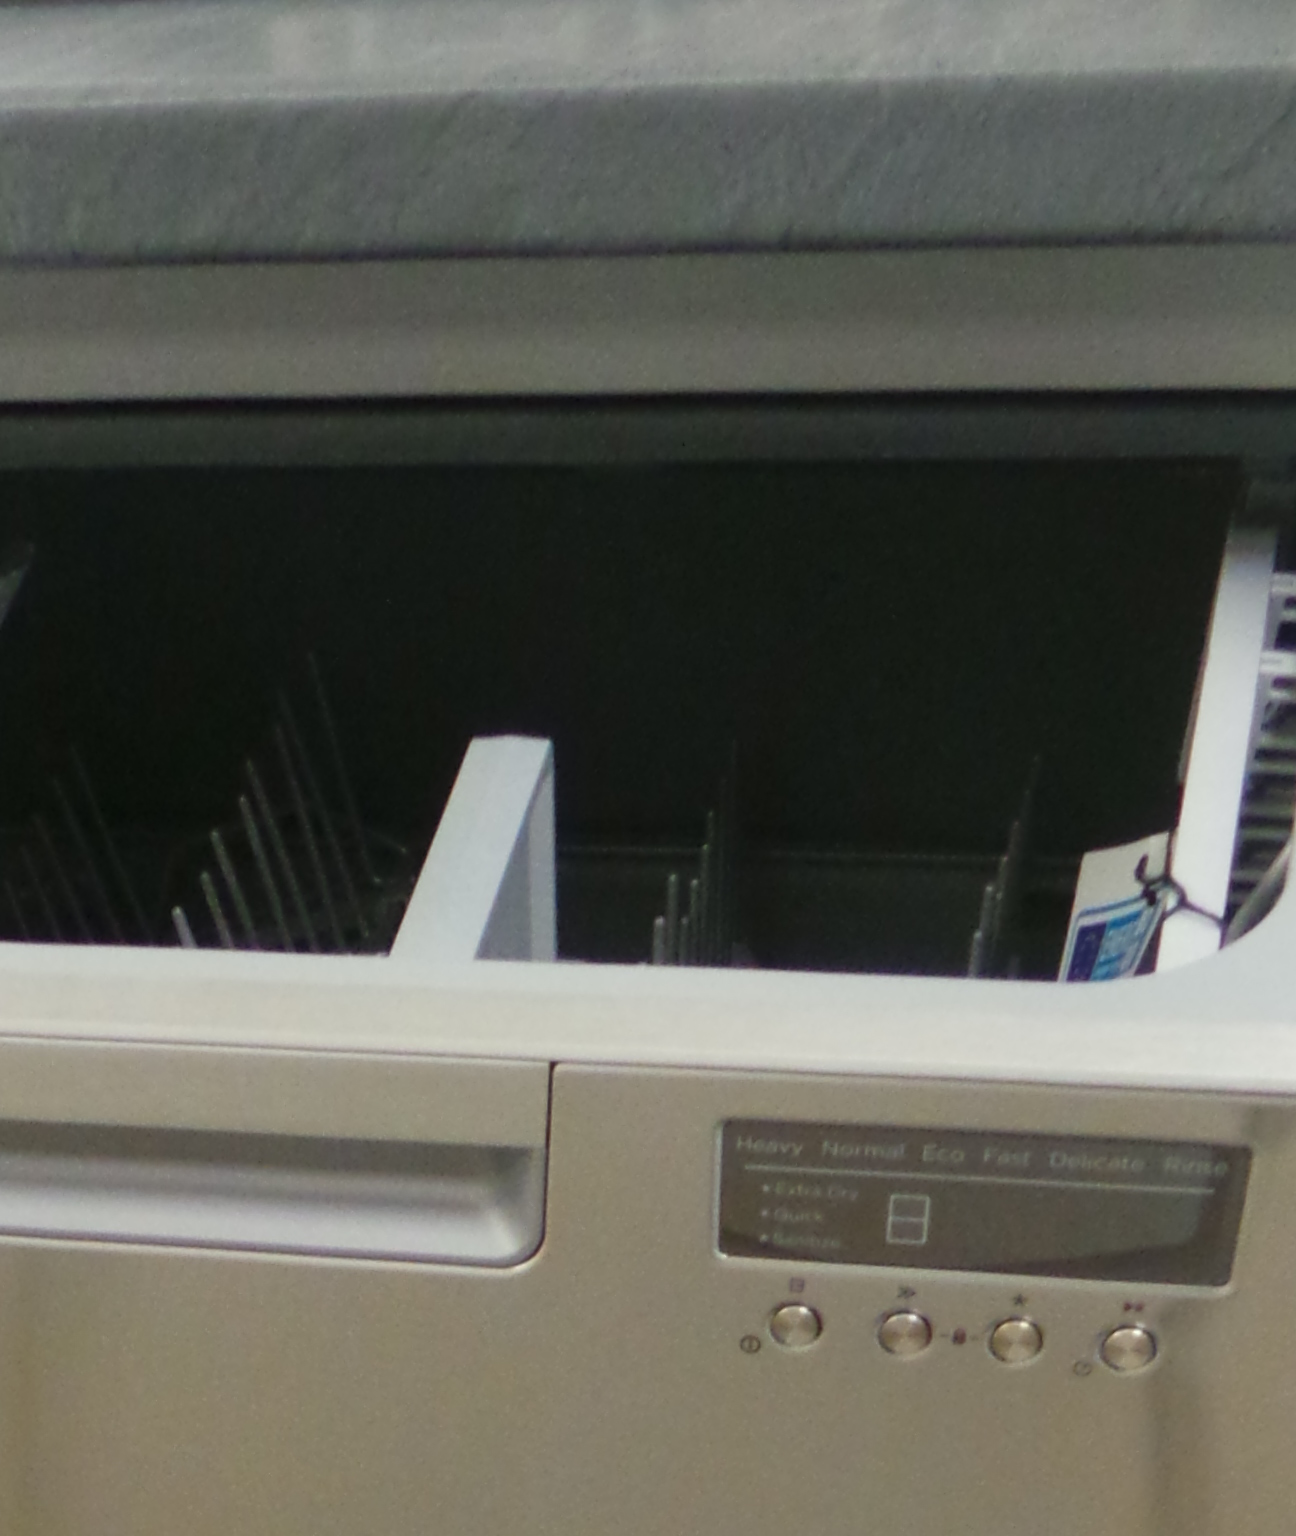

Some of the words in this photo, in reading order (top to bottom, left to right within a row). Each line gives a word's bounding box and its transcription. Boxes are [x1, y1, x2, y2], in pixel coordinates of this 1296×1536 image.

[736, 1135, 802, 1157] Heavy
[822, 1140, 905, 1157] Normal
[922, 1143, 965, 1163] Eco
[983, 1147, 1030, 1166] Fast
[1049, 1151, 1145, 1172] Delicate
